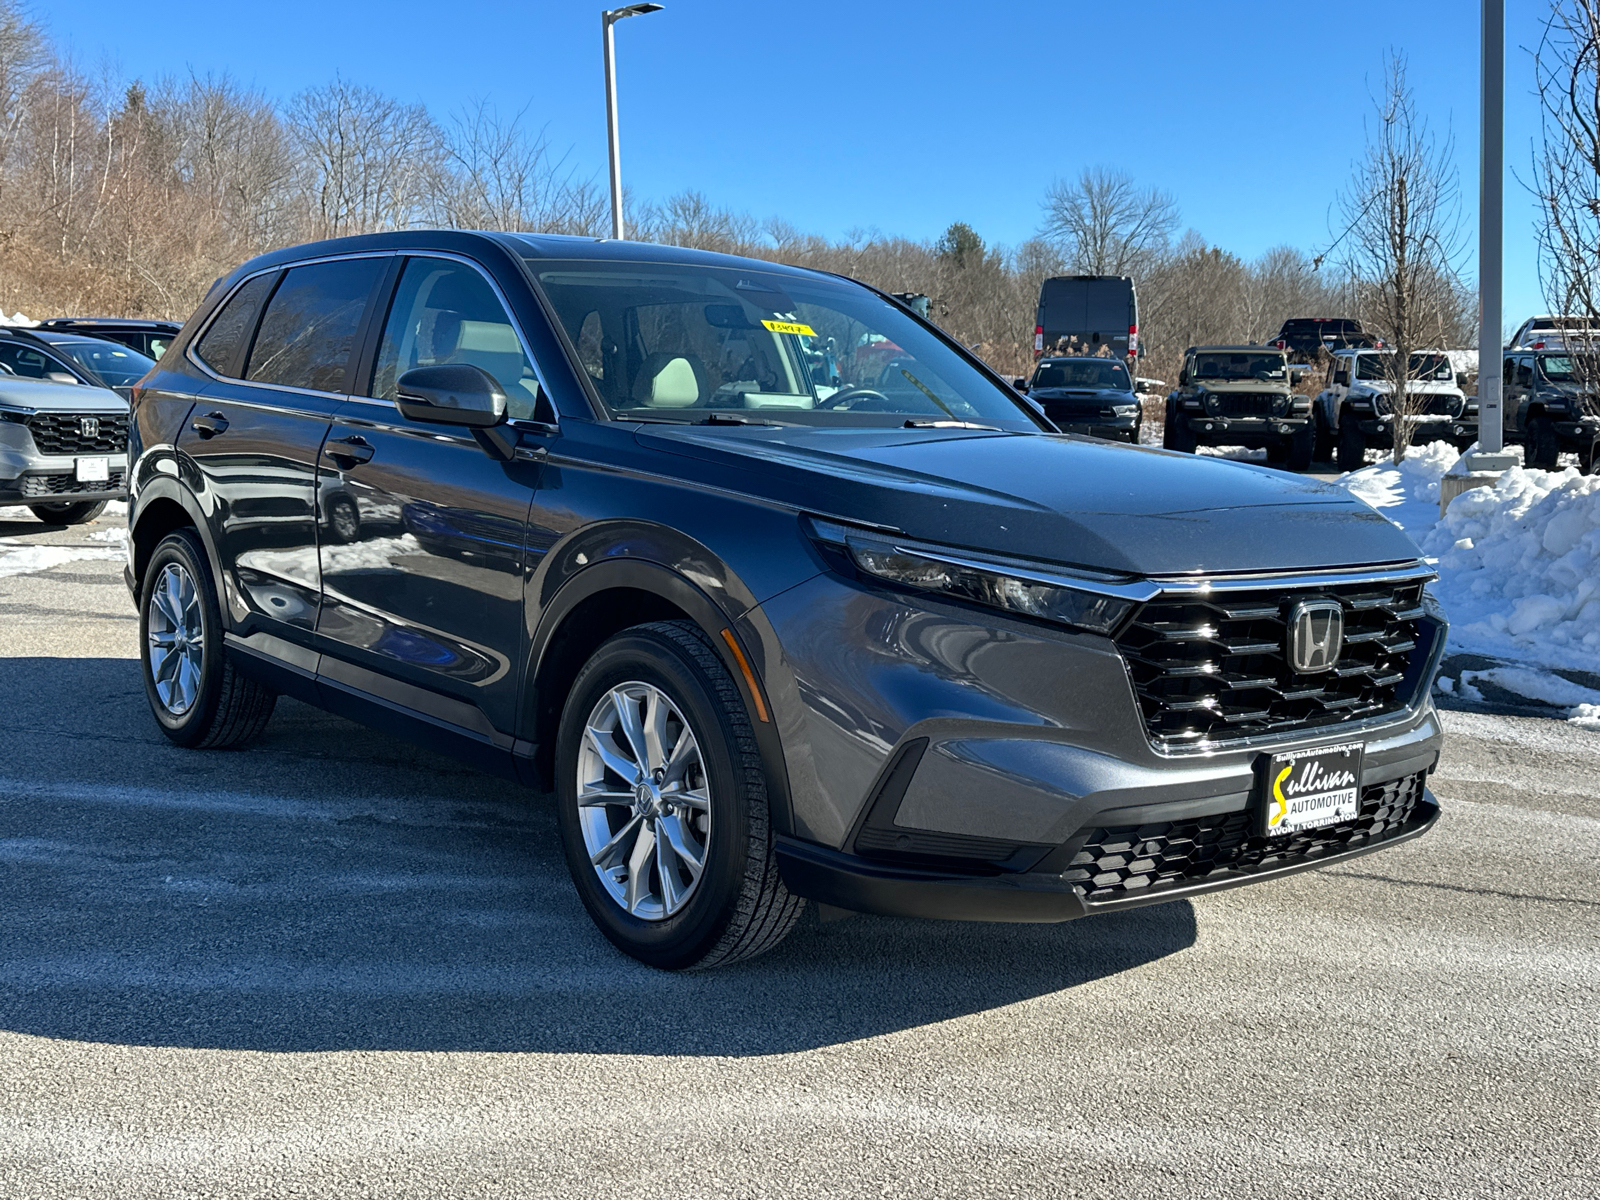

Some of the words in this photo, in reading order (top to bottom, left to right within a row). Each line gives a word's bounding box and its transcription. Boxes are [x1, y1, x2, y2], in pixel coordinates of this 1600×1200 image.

[1300, 608, 1336, 669] H
[1276, 743, 1363, 762] SullivanAutomotive.com
[1270, 761, 1355, 826] Sullivan
[1290, 792, 1353, 814] AUTOMOTIVE
[1270, 825, 1294, 836] AVON
[1302, 811, 1357, 829] TORRINGTON
